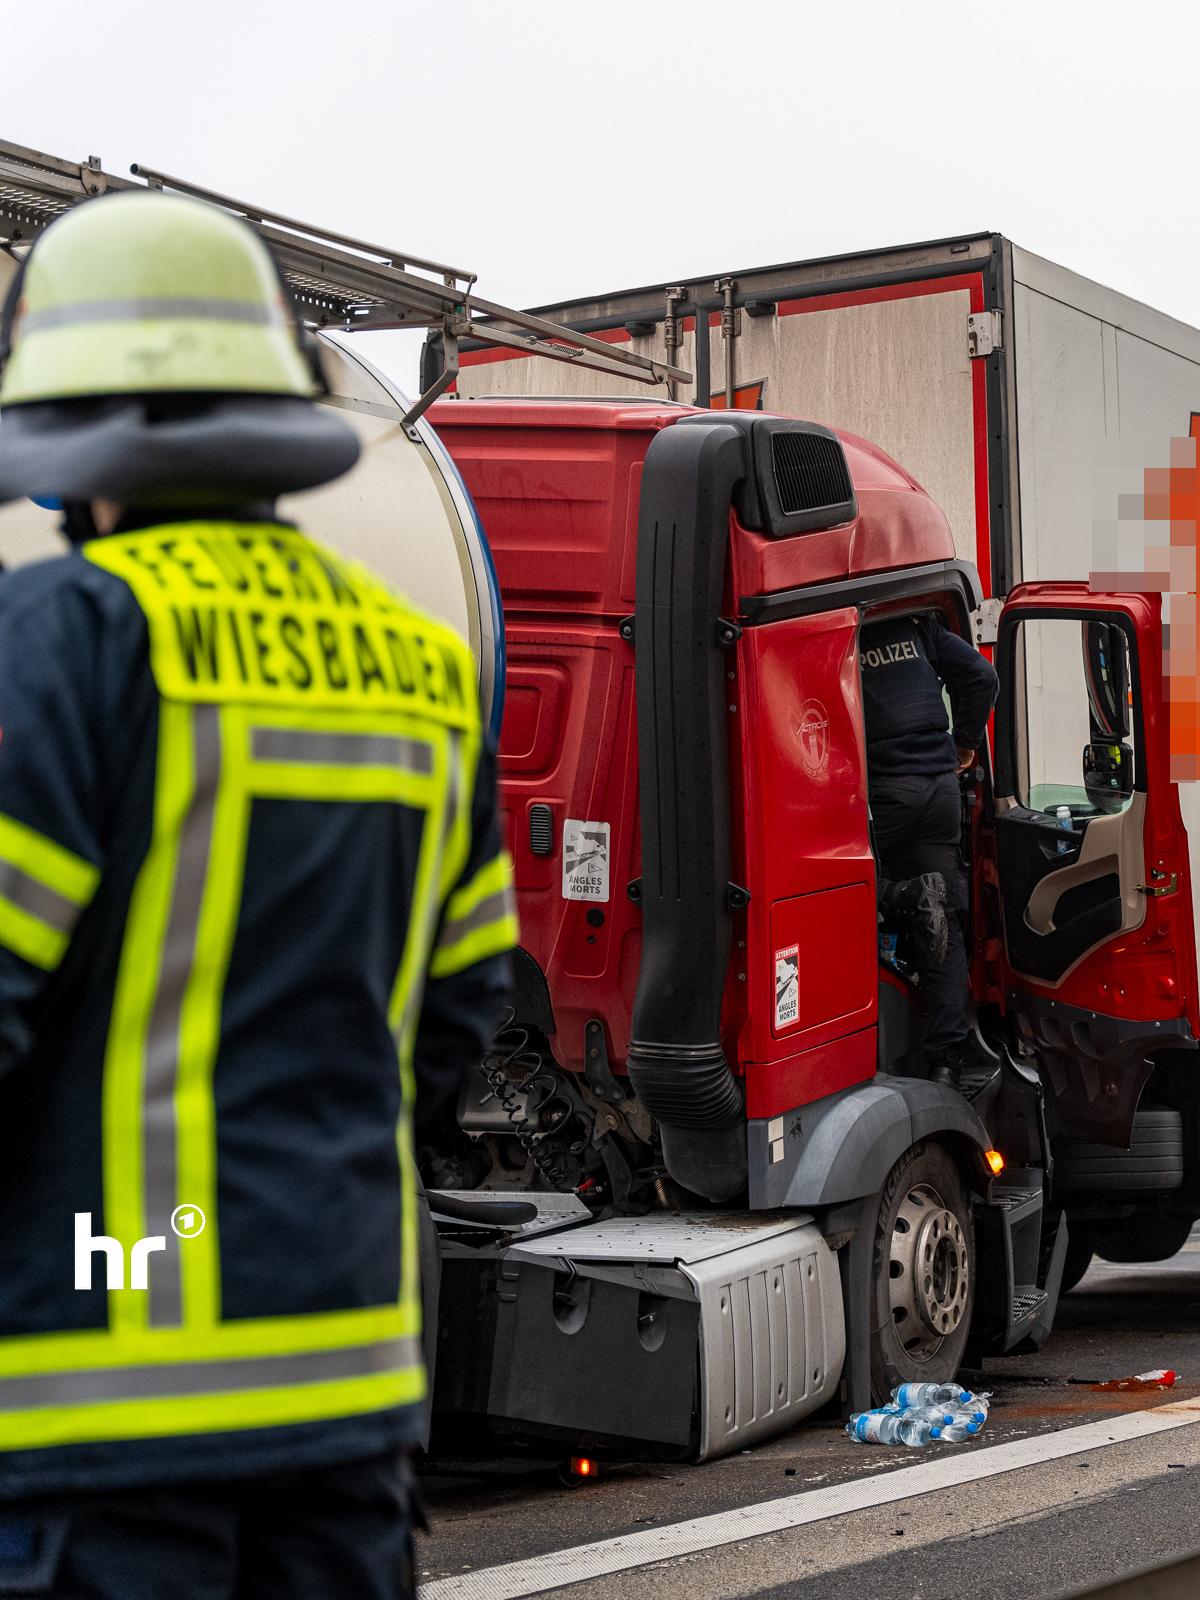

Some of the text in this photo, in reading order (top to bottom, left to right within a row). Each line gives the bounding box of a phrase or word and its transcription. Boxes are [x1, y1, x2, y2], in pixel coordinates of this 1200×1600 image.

[170, 603, 468, 709] WIESBADEN
[860, 640, 919, 671] POLIZEI
[797, 720, 828, 735] ACTROS
[569, 875, 602, 885] ANGLES
[570, 885, 600, 894] MORTS
[778, 1000, 796, 1013] ANGLES
[779, 1008, 796, 1021] MORTS
